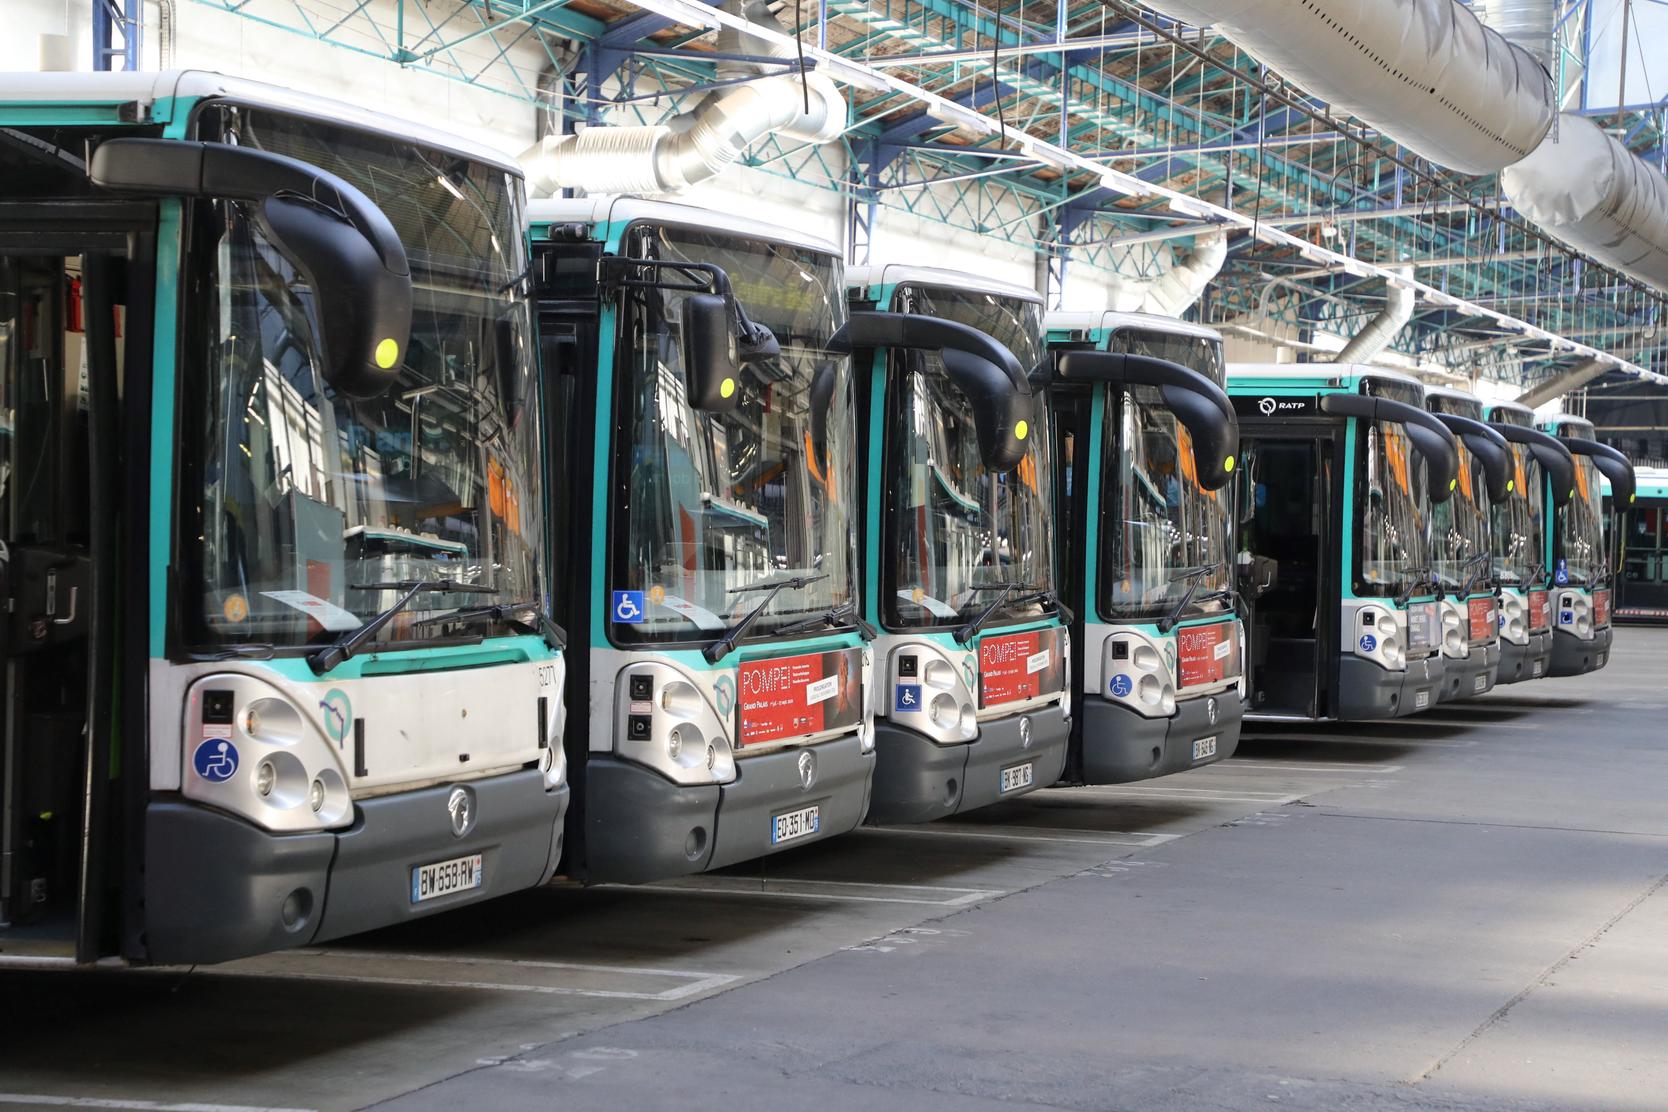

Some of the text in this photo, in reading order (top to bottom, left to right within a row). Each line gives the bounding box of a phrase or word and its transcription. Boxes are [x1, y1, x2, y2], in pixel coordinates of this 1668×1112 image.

[983, 641, 1017, 665] POMPEI
[743, 666, 790, 695] POMPEI
[421, 859, 474, 896] BW-658-RW
